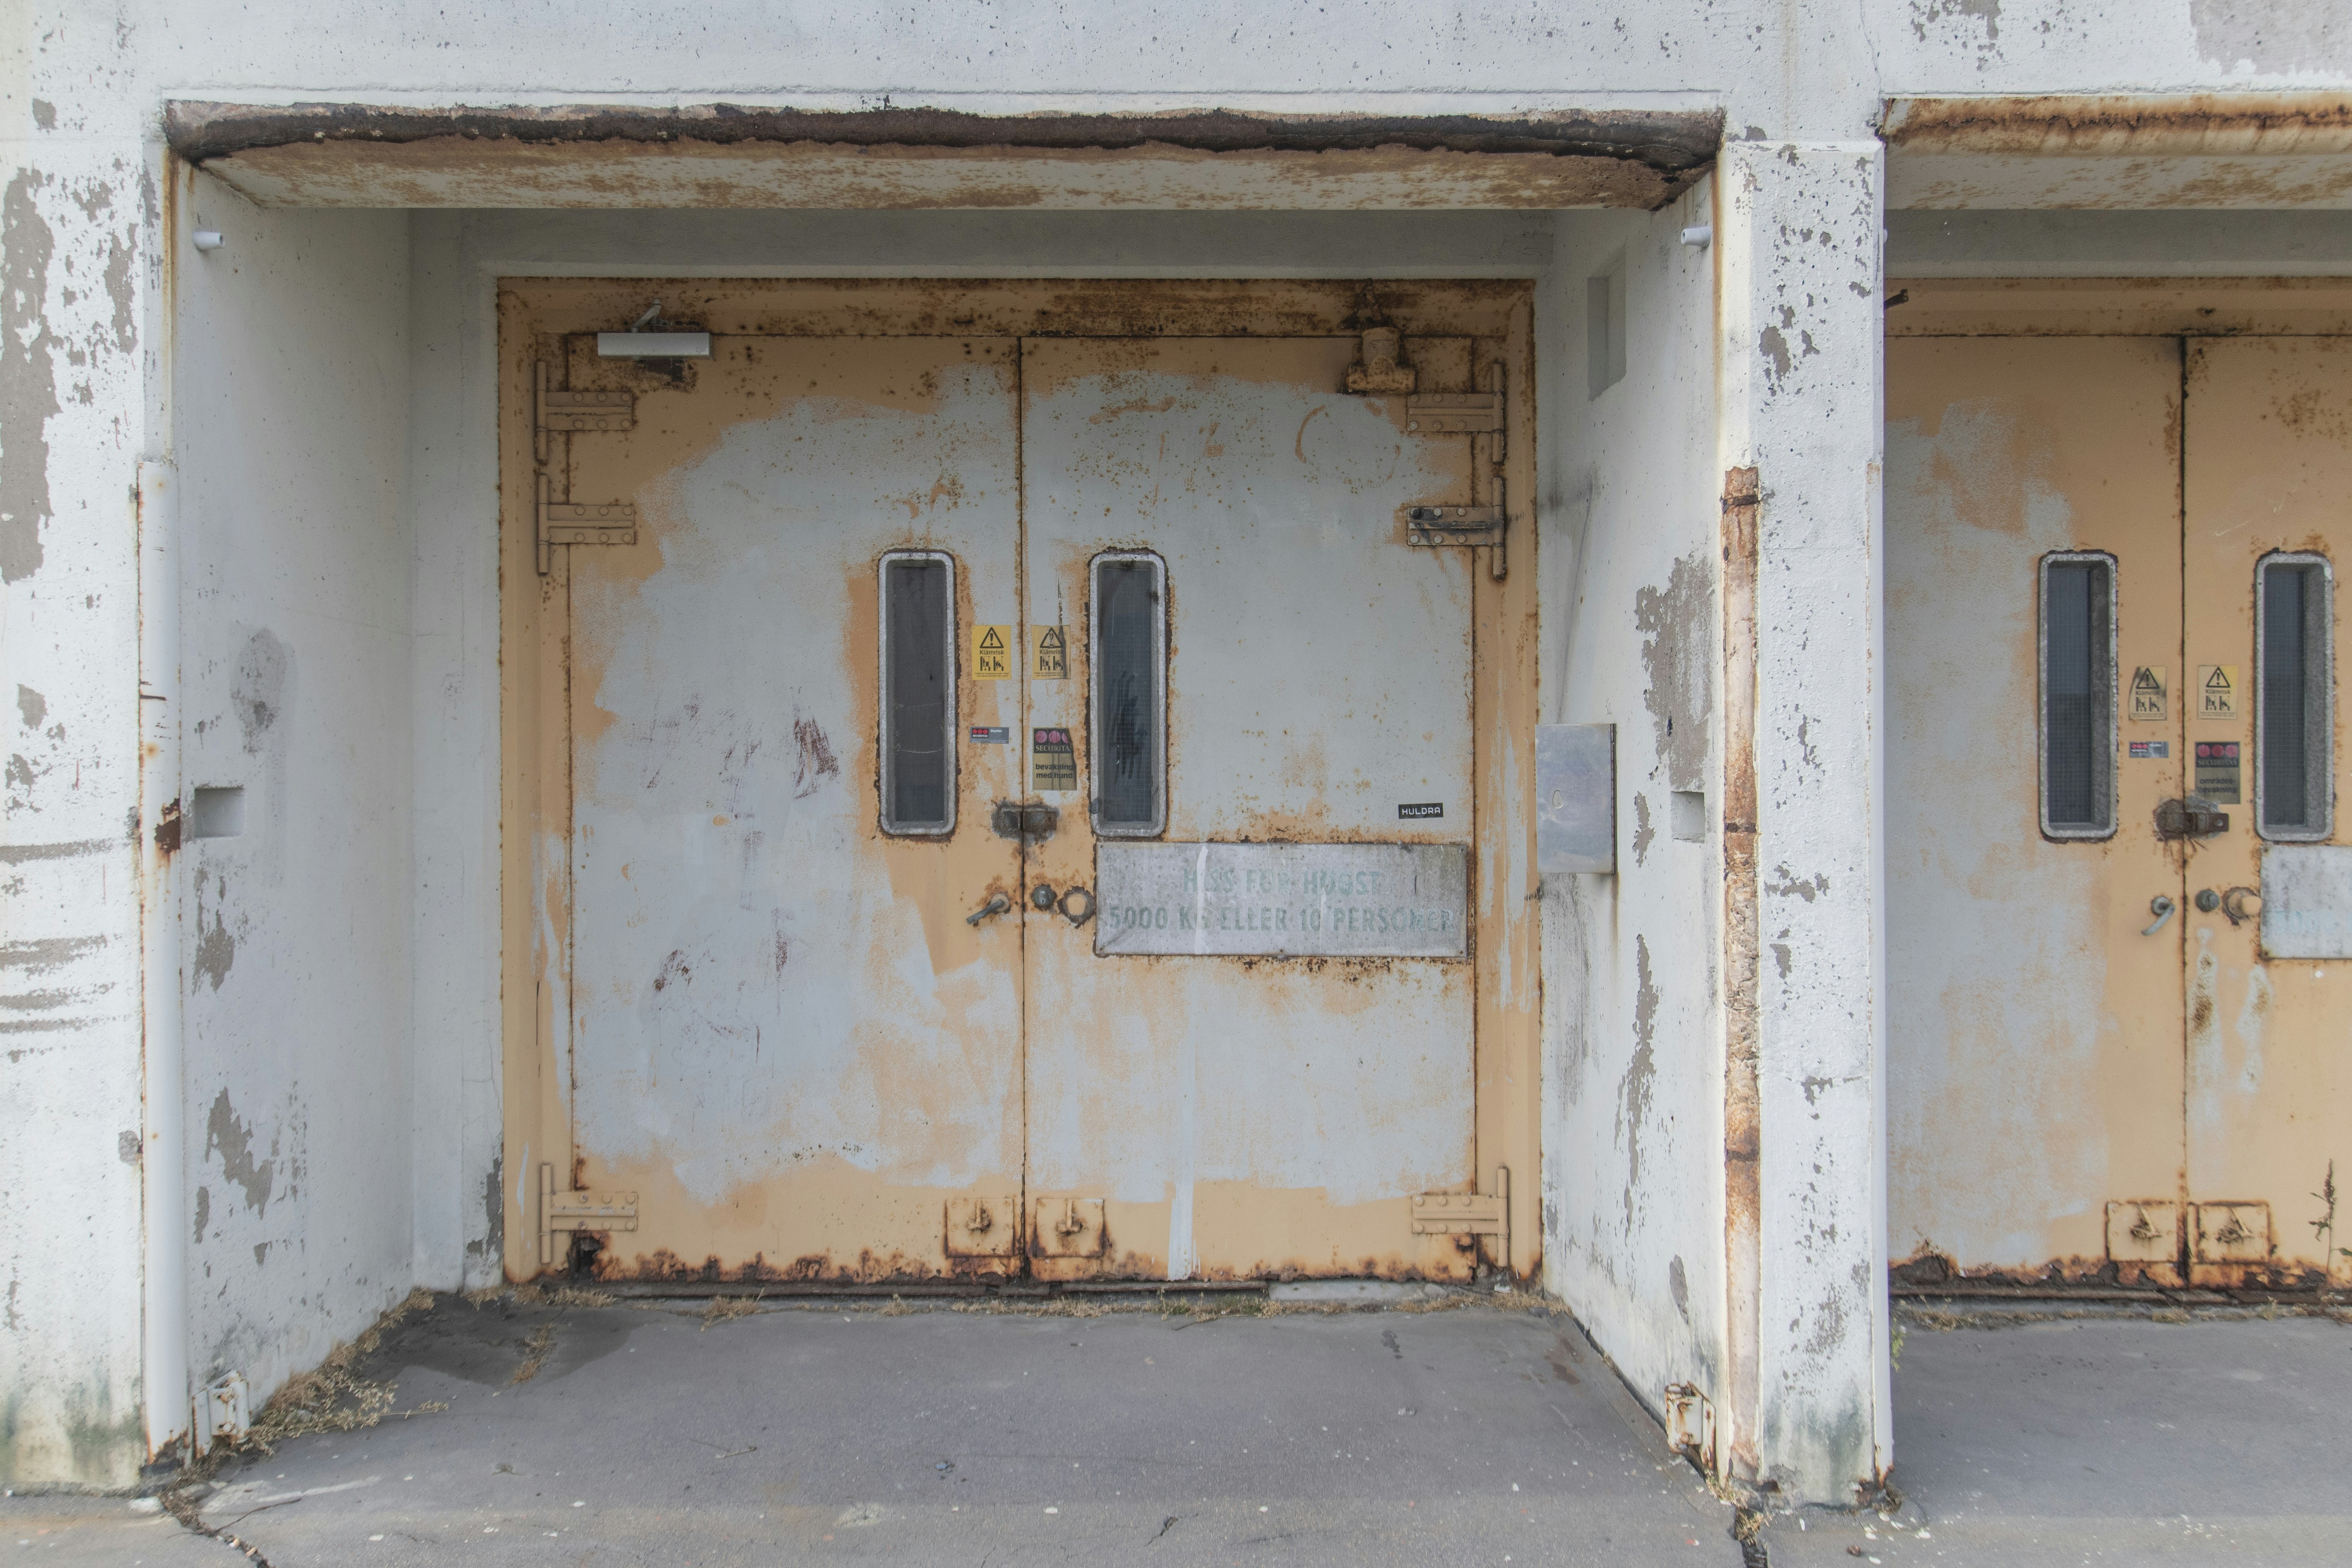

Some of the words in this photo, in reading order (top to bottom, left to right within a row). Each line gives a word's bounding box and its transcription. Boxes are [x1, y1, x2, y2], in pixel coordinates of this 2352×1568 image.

[1402, 807, 1440, 815] HULDRA
[1183, 868, 1234, 893] HSS
[1109, 906, 1168, 930] 5000
[1220, 907, 1288, 931] ELLER
[1301, 908, 1321, 932] 10
[1334, 908, 1454, 933] PERSONER
